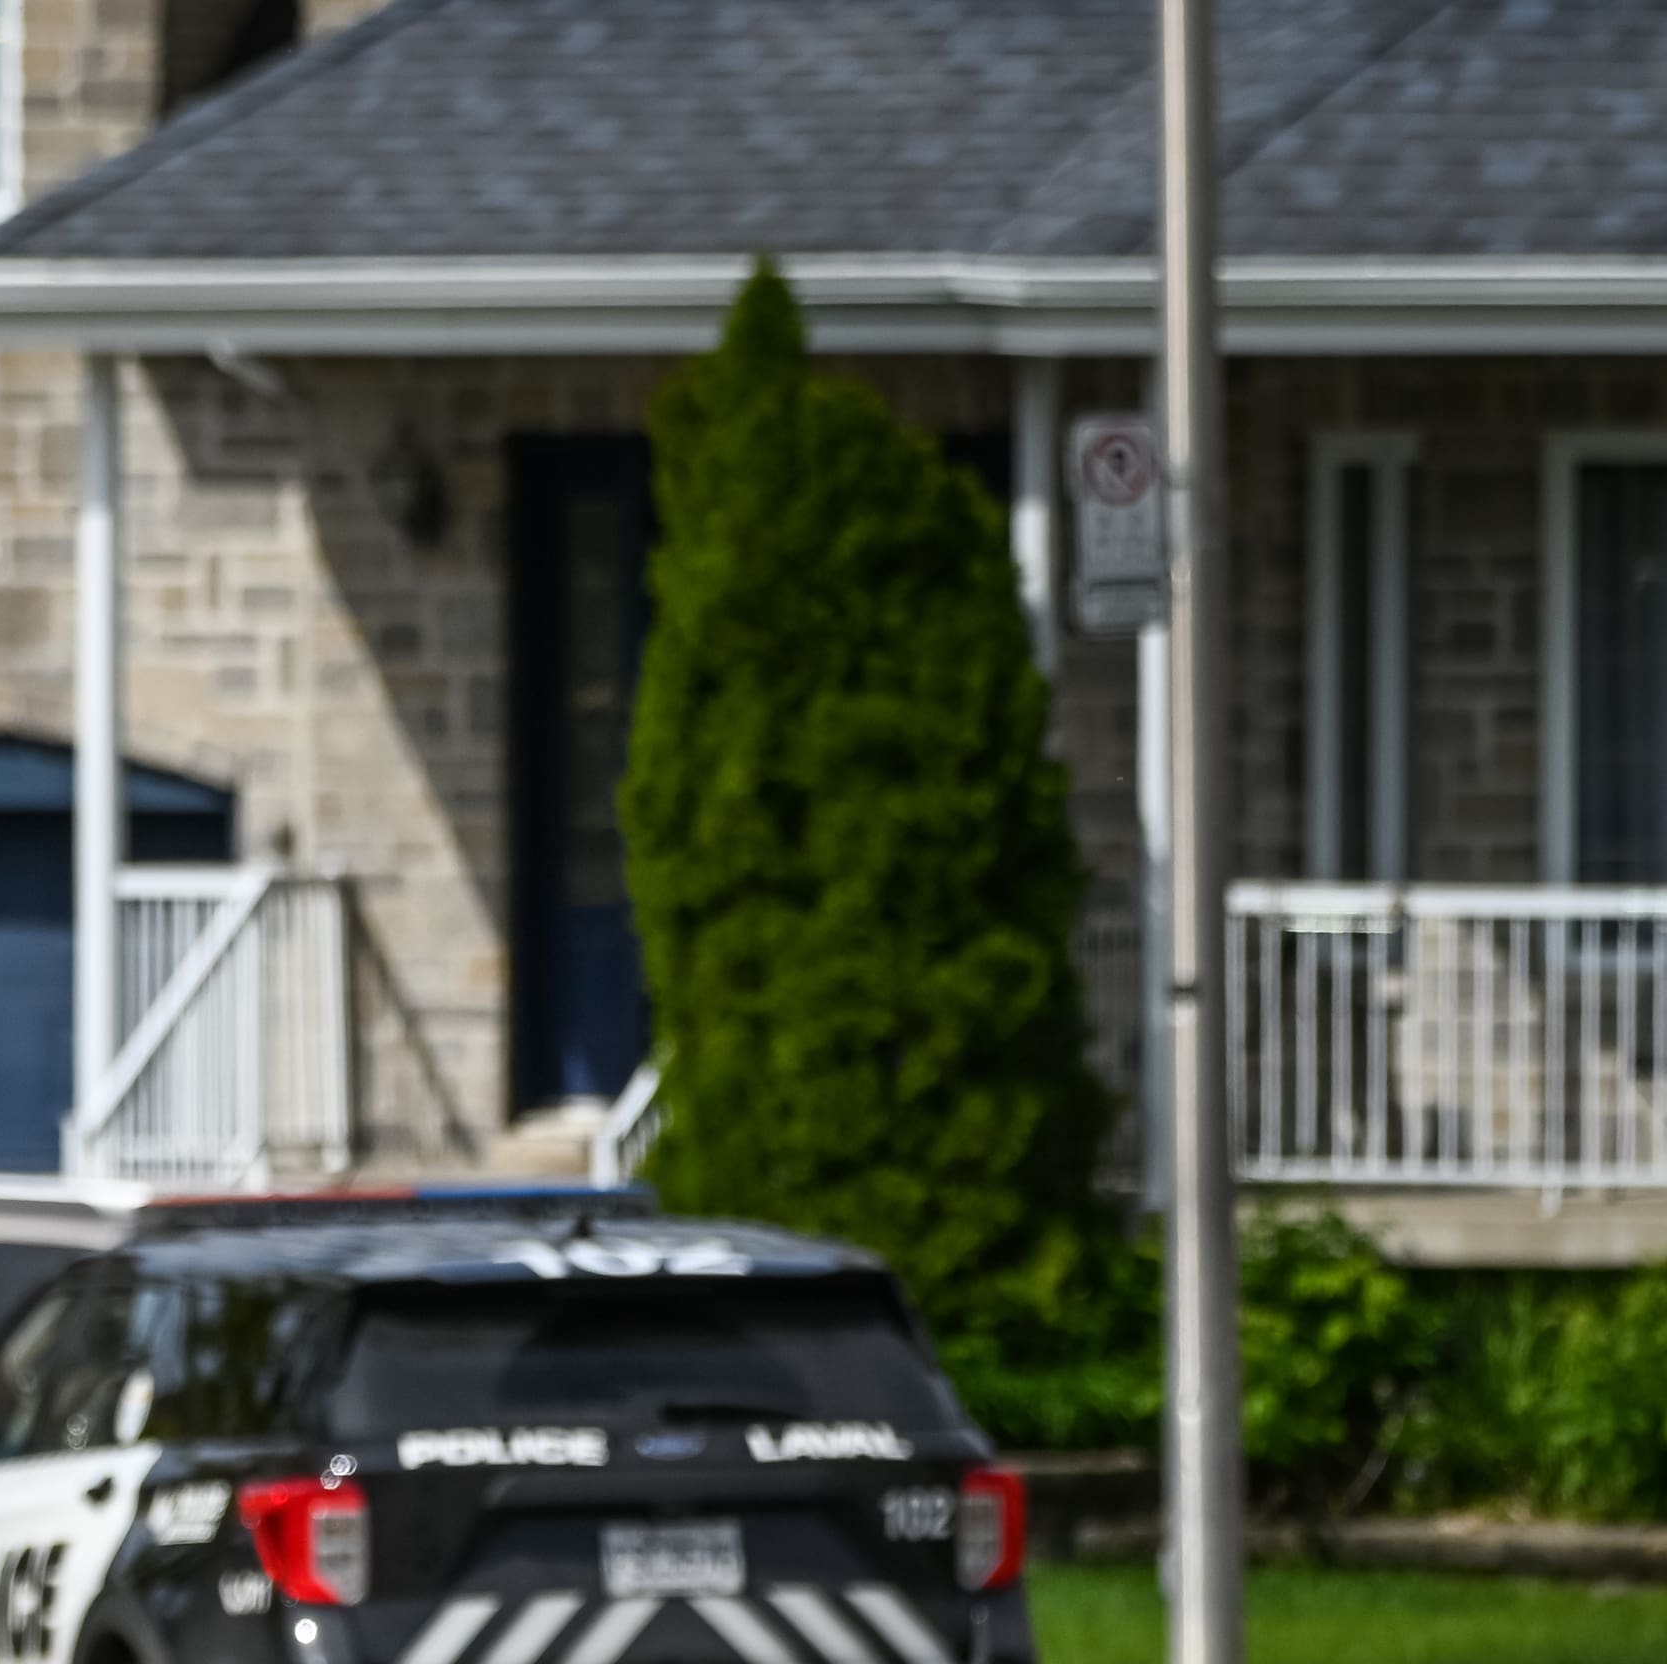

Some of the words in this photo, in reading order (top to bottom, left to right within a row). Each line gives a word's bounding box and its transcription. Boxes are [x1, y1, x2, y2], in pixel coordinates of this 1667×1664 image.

[397, 1427, 608, 1470] POLICE
[745, 1422, 912, 1462] LAVAL
[881, 1488, 950, 1541] 102
